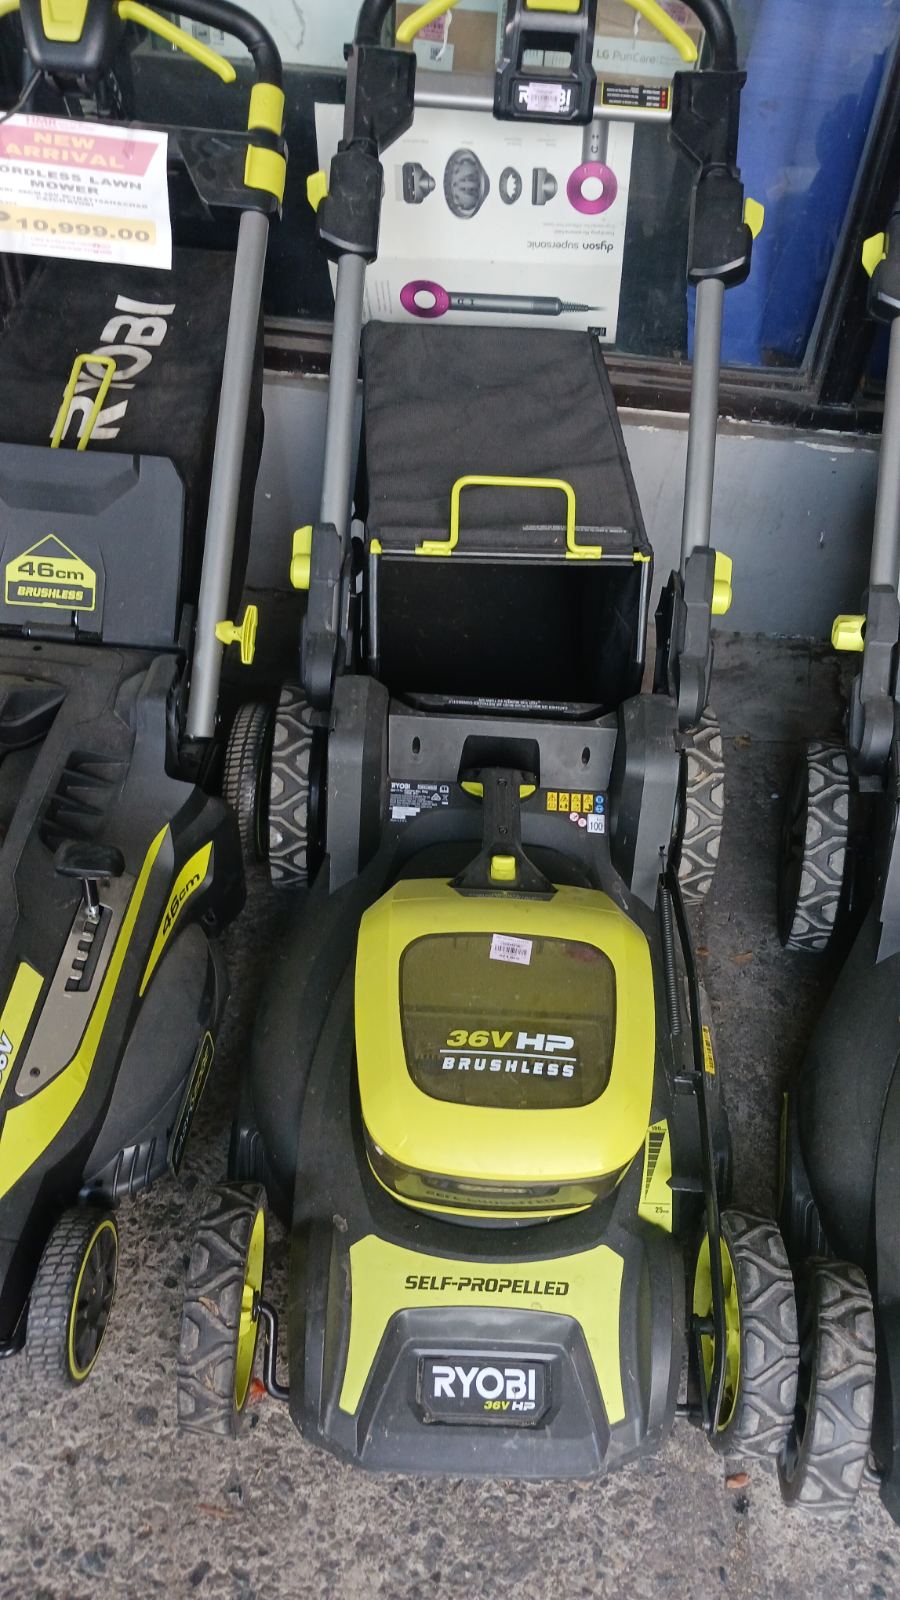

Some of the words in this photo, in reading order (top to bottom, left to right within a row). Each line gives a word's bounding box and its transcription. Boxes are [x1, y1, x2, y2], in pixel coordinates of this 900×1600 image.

[596, 48, 610, 60] LG
[612, 50, 656, 65] PuriCare
[518, 85, 572, 106] RBI
[33, 131, 96, 150] NEW
[4, 142, 125, 169] ARRIVAL
[0, 165, 82, 183] ORDLESS
[89, 176, 143, 192] LAWN
[30, 179, 100, 195] MOWER
[527, 240, 580, 251] supersonic
[582, 240, 614, 254] dyson
[17, 561, 85, 581] 46cm
[16, 585, 84, 602] BRUSHLESS
[590, 821, 604, 832] 100
[161, 871, 201, 938] 46cm
[446, 1029, 513, 1049] 36V
[515, 1031, 575, 1053] HP
[441, 1056, 575, 1079] BRUSHLESS
[405, 1275, 570, 1297] SELF-PROPELLED
[432, 1364, 536, 1401] RYOBI
[483, 1400, 511, 1412] 36V
[511, 1401, 536, 1412] HP
